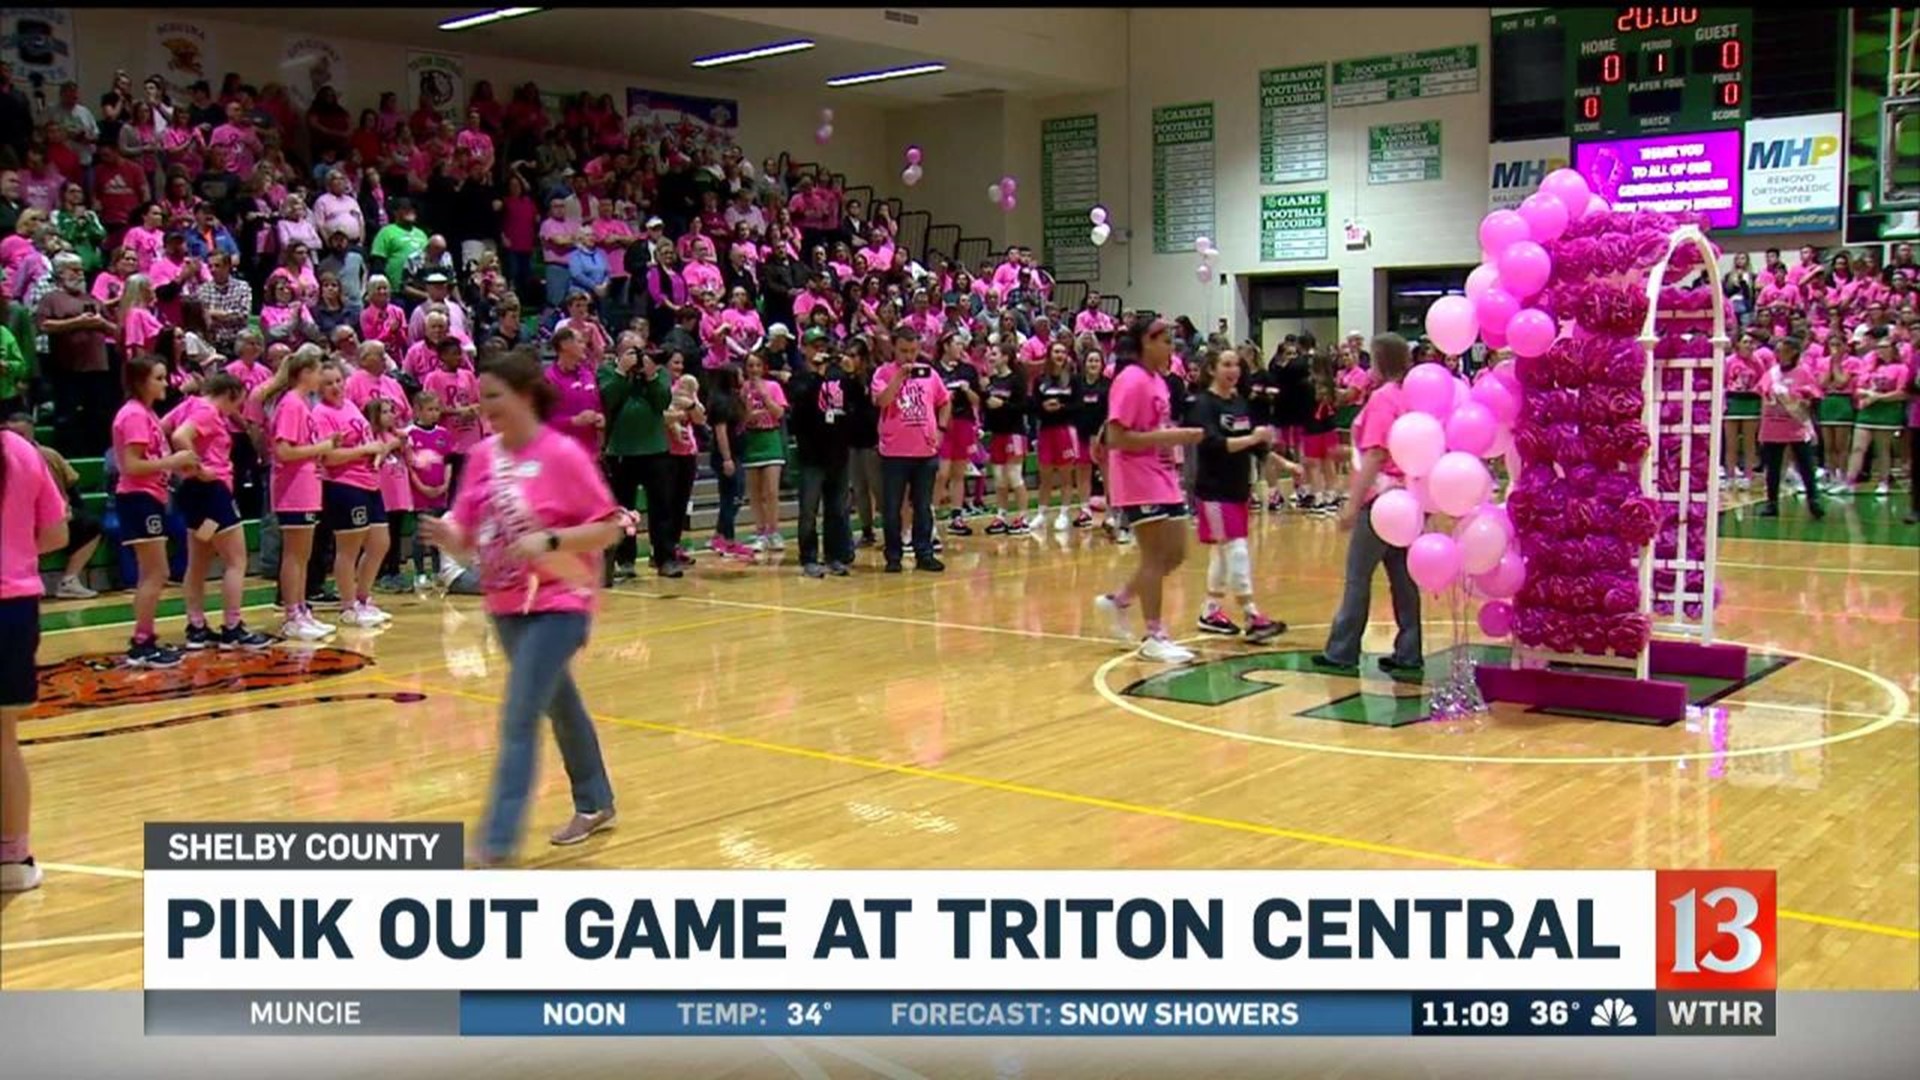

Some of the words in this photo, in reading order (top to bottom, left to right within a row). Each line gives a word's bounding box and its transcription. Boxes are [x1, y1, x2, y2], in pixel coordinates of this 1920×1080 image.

[1695, 23, 1739, 41] GUEST
[1581, 38, 1618, 54] HOME
[1641, 39, 1672, 51] PERIOD
[1722, 41, 1740, 69] 0
[1604, 54, 1620, 82] 0
[1273, 68, 1323, 83] SEASON
[1712, 71, 1741, 84] FOULS
[1261, 80, 1324, 97] FOOTBALL
[1574, 86, 1601, 98] FOULS
[1628, 80, 1661, 93] PLAYER
[1663, 77, 1686, 89] FOUL
[1265, 93, 1321, 107] RECORDS
[1724, 83, 1739, 104] 0
[1165, 106, 1212, 119] CAREER
[1584, 97, 1597, 118] 0
[1640, 116, 1670, 127] MATCH
[1712, 109, 1741, 121] SCORE
[1154, 118, 1213, 133] FOOTBALL
[1574, 122, 1600, 133] SCORE
[1157, 131, 1211, 144] RECORDS
[1748, 136, 1839, 170] MHP
[1767, 173, 1816, 185] RENOVO
[1751, 183, 1831, 196] ORTHOPAEDIC
[1277, 194, 1321, 207] GAME
[1769, 194, 1812, 205] CENTER
[1262, 206, 1325, 220] FOOTBALL
[1265, 217, 1323, 231] RECORDS
